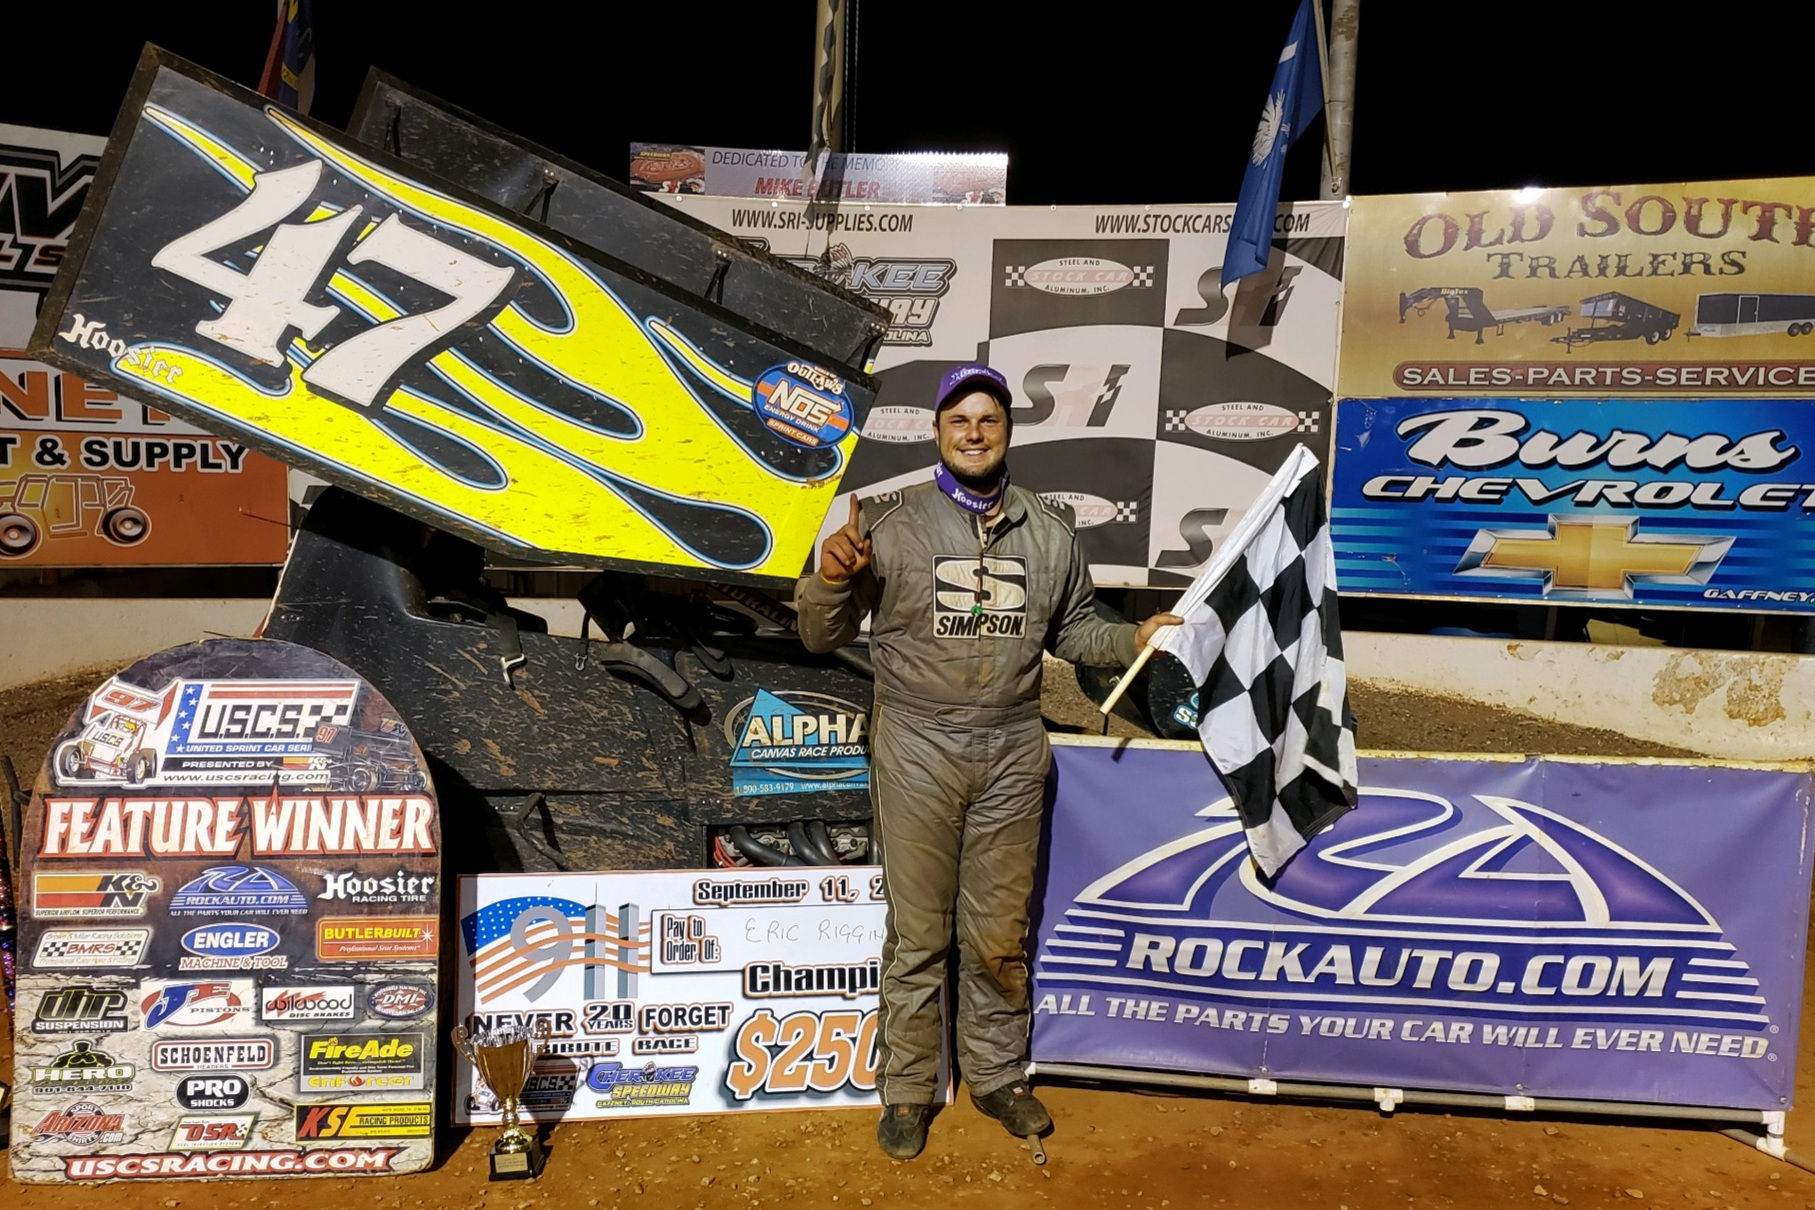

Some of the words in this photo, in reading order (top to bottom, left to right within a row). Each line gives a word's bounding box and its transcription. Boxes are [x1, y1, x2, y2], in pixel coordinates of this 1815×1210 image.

[712, 151, 788, 168] DEDICATED
[755, 177, 803, 196] MIKE
[1095, 213, 1310, 235] WWW.STOCKCARSCOM
[1403, 200, 1555, 259] OLD
[1059, 259, 1081, 267] STEEL
[1084, 258, 1100, 267] AND
[1486, 250, 1747, 280] TRAILERS
[151, 159, 515, 407] 47
[1030, 270, 1087, 282] STOCK
[1095, 270, 1131, 282] CAR
[58, 313, 183, 384] Hoosier
[767, 379, 843, 428] NOS
[1222, 404, 1244, 412] STEEL
[768, 418, 796, 436] SPRINT
[795, 417, 820, 433] DRINK
[1194, 415, 1250, 427] STOCK
[1258, 415, 1296, 427] CAR
[1397, 410, 1796, 469] Burns
[35, 438, 67, 466] &
[84, 440, 246, 471] SUPPLY
[1081, 507, 1112, 516] CAR
[936, 615, 1022, 636] SIMPSON
[92, 730, 124, 748] USCS
[741, 713, 869, 748] ALPHA
[185, 744, 224, 753] UNITED
[226, 744, 263, 753] SPRINT
[265, 744, 285, 752] CAR
[288, 744, 313, 752] SERI
[751, 747, 797, 759] CANVAS
[799, 746, 828, 758] RACE
[829, 745, 870, 756] PRODU
[182, 760, 255, 769] PRESENTED
[256, 760, 273, 768] BY
[163, 771, 331, 783] www.uscsracing.com
[43, 801, 245, 854] FEATURE
[251, 800, 436, 854] WINNER
[317, 870, 435, 900] Hoosier
[697, 879, 807, 903] September
[824, 877, 859, 899] 11,
[185, 895, 290, 905] ROCKAUTO.COM
[352, 895, 397, 903] RACING
[666, 916, 686, 940] Pay
[692, 917, 703, 937] to
[745, 917, 801, 943] ERIC
[818, 919, 885, 943] RIGGIN
[66, 943, 115, 955] BMRS
[194, 932, 270, 949] ENGLER
[666, 942, 696, 962] Order
[704, 938, 720, 961] Of:
[179, 957, 240, 971] MACHINE
[240, 957, 252, 970] &
[254, 955, 288, 970] TOOL
[1126, 932, 1676, 998] ROCKAUTO.COM
[749, 960, 879, 996] Champi
[383, 993, 417, 1005] DMI
[588, 1004, 632, 1020] 20
[645, 1005, 731, 1028] FORGET
[35, 1021, 124, 1031] SUSPENSION
[588, 1019, 635, 1030] YEARS
[1033, 993, 1097, 1016] ALL
[1106, 997, 1170, 1022] THE
[1173, 1003, 1291, 1035] PARTS
[1299, 1015, 1396, 1042] YOUR
[1400, 1019, 1474, 1045] CAR
[1482, 1023, 1564, 1049] WILL
[1570, 1027, 1665, 1053] EVER
[309, 1037, 414, 1060] FireAde
[535, 1040, 617, 1055] RIBUTE
[637, 1036, 696, 1050] RACE
[727, 1010, 881, 1098] $250
[160, 1045, 266, 1065] SCHOENFELD
[35, 1066, 133, 1081] HERO
[187, 1080, 241, 1098] PRO
[612, 1083, 692, 1099] SPEEDWAY
[70, 1104, 99, 1113] SPORT
[190, 1099, 234, 1108] SHOCKS
[360, 1116, 388, 1126] RACING
[389, 1114, 429, 1125] PRODUCTS
[68, 1152, 388, 1177] USCSRACING.COM
